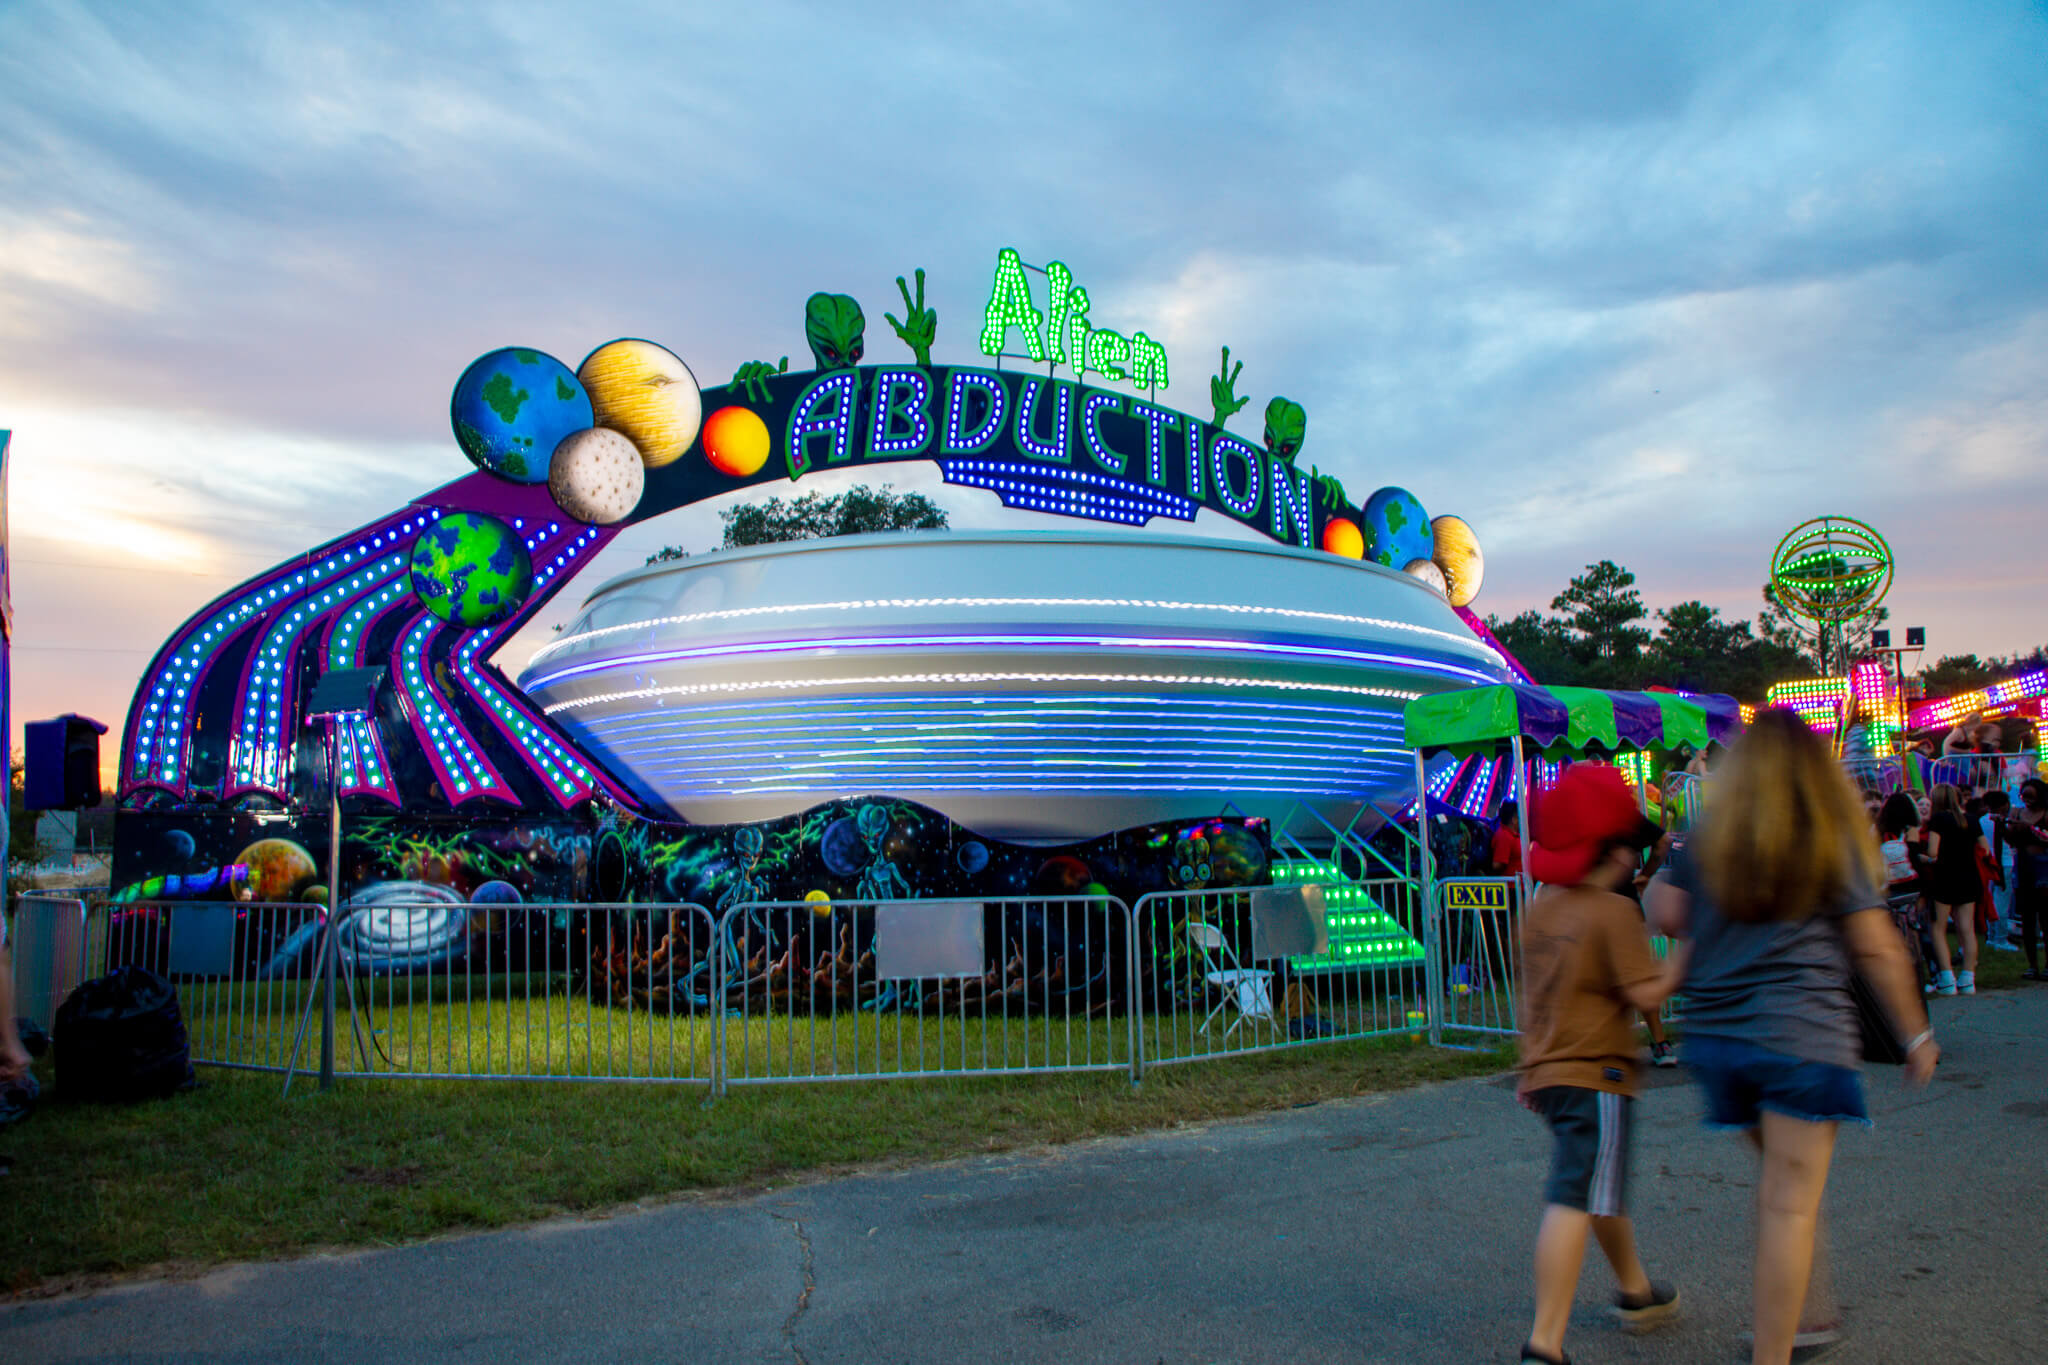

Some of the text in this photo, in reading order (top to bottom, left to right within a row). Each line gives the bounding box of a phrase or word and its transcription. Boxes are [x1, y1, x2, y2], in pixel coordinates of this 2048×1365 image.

[980, 247, 1168, 390] Alien
[786, 367, 1314, 549] ABDUCTION
[1452, 886, 1502, 905] EXIT
